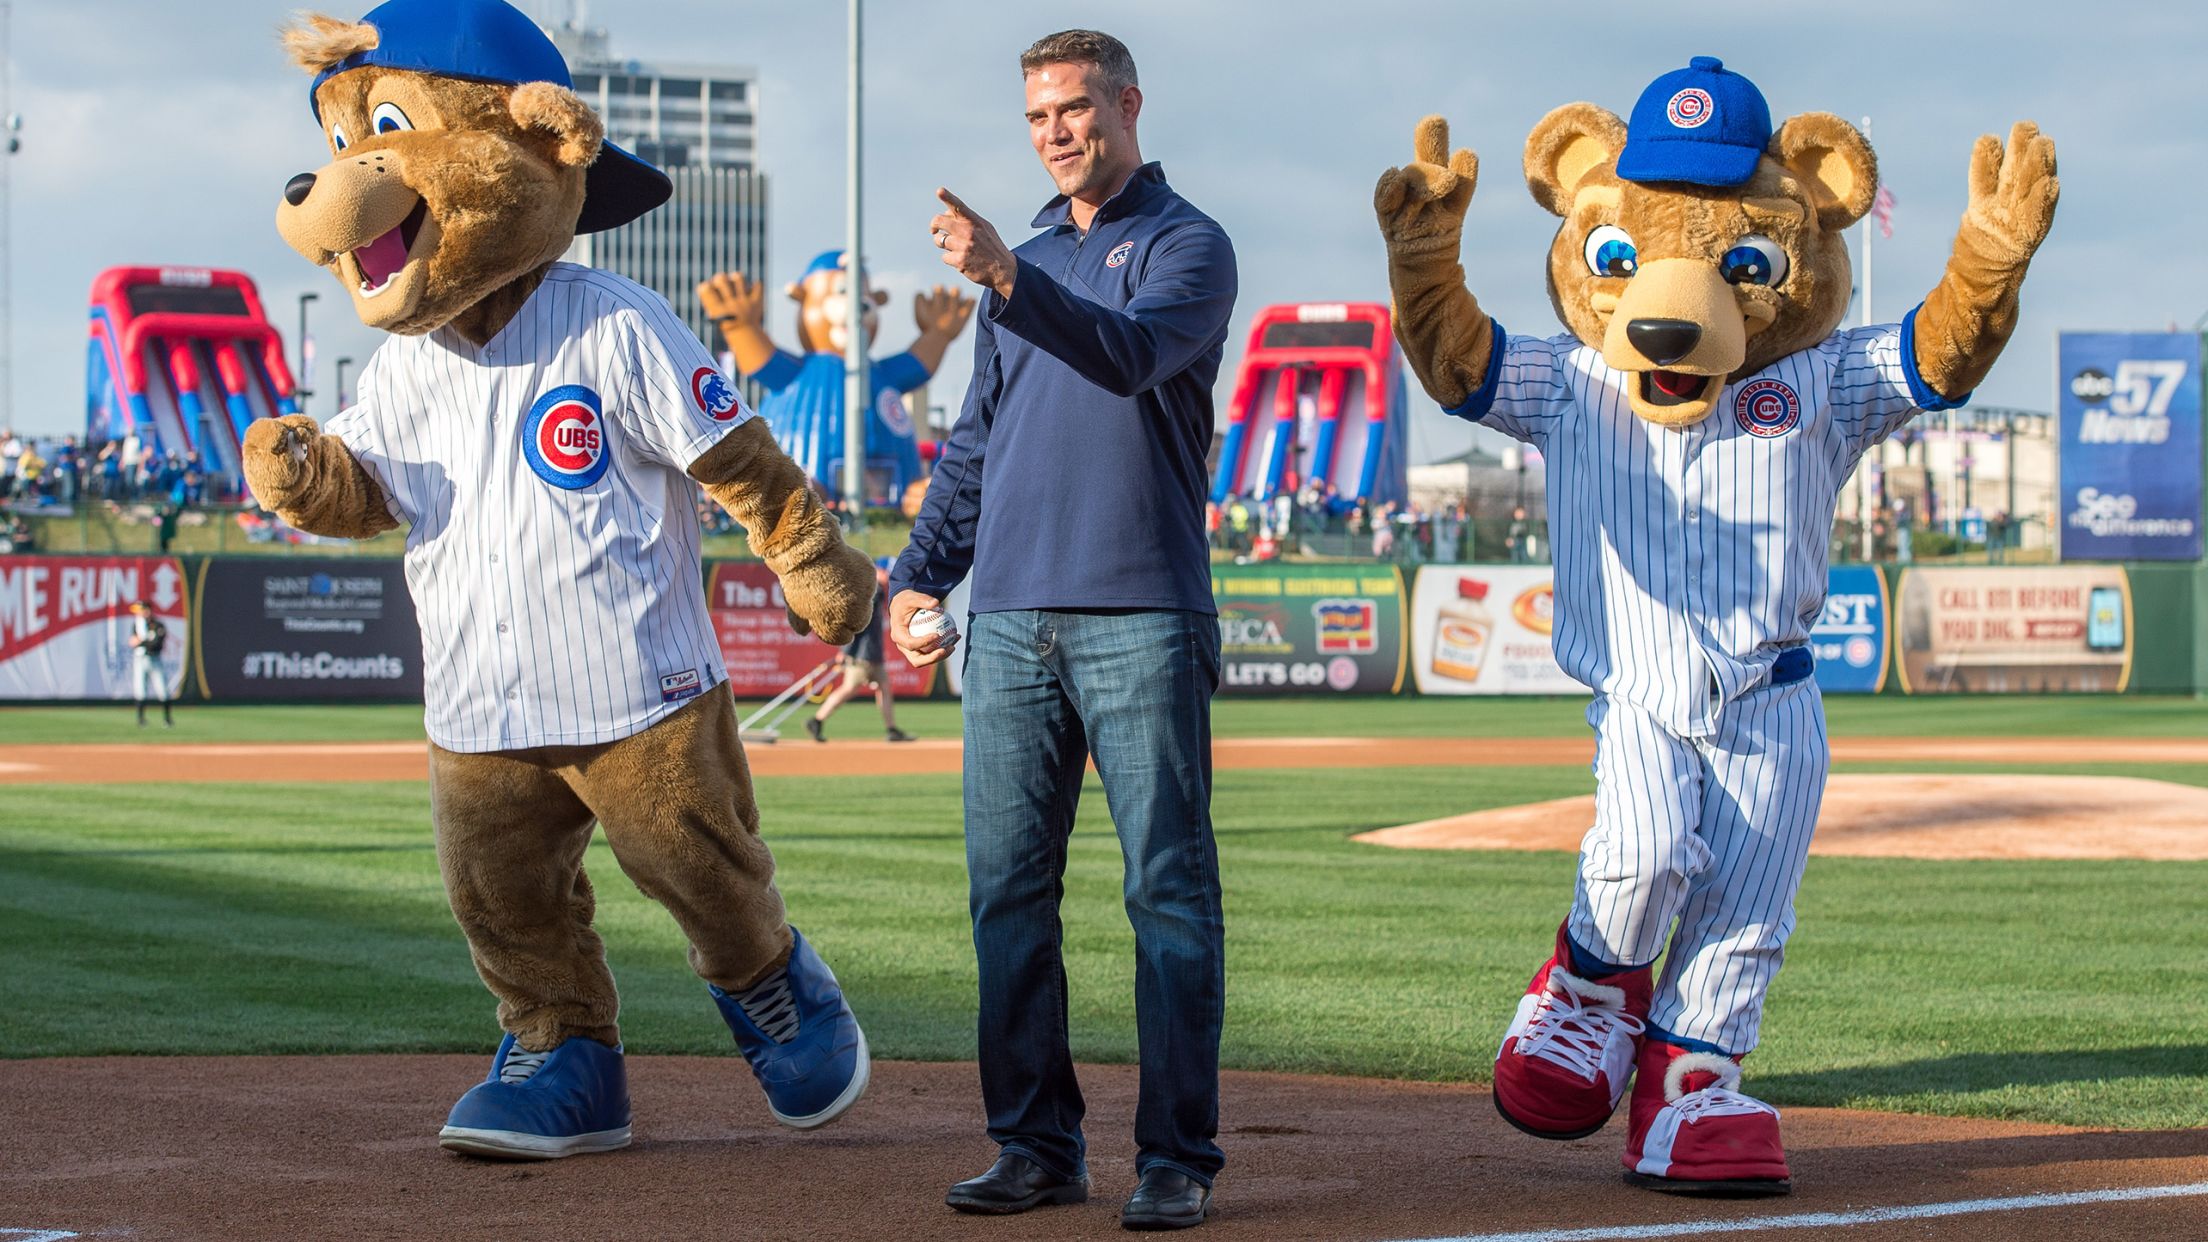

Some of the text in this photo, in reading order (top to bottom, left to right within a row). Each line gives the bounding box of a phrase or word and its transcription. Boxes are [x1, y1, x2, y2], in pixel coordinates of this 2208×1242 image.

[2110, 359, 2188, 417] 57
[541, 403, 600, 470] CUBS
[2079, 408, 2172, 445] News
[2077, 486, 2138, 520] See
[59, 565, 138, 622] RUN
[722, 581, 767, 607] The
[1939, 587, 1978, 609] CALL
[2018, 586, 2081, 611] BEFORE
[1941, 619, 1976, 641] YOU
[242, 652, 404, 679] #ThisCounts
[1226, 662, 1325, 685] LET'S GO
